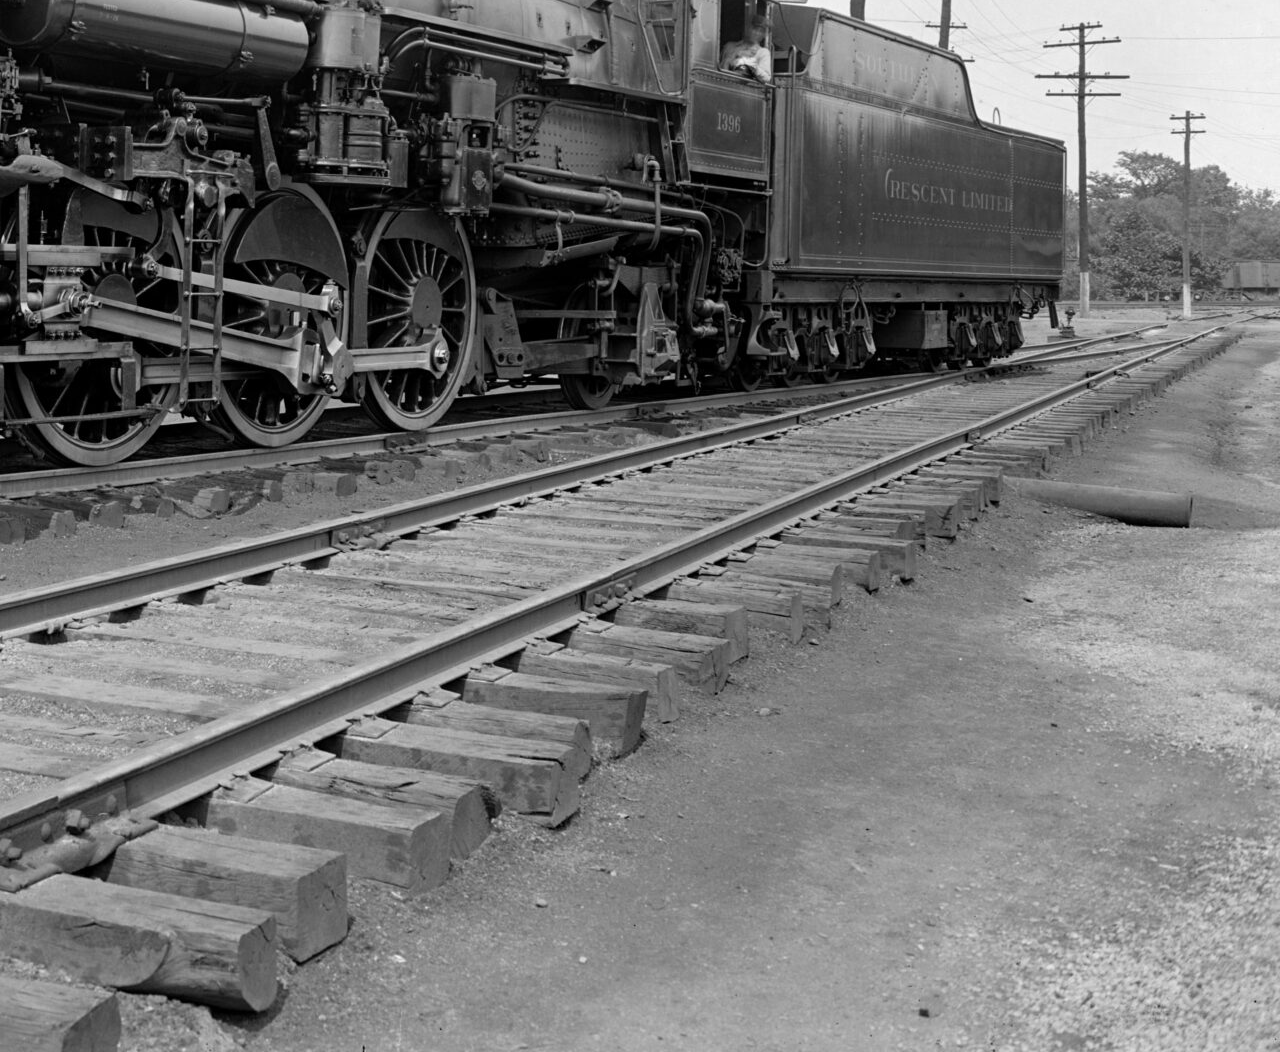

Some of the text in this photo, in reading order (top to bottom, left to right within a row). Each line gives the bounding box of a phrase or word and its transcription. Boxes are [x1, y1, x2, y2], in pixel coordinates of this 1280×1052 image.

[716, 112, 742, 134] 1396
[884, 167, 1014, 213] CRESCENT LIMITED
